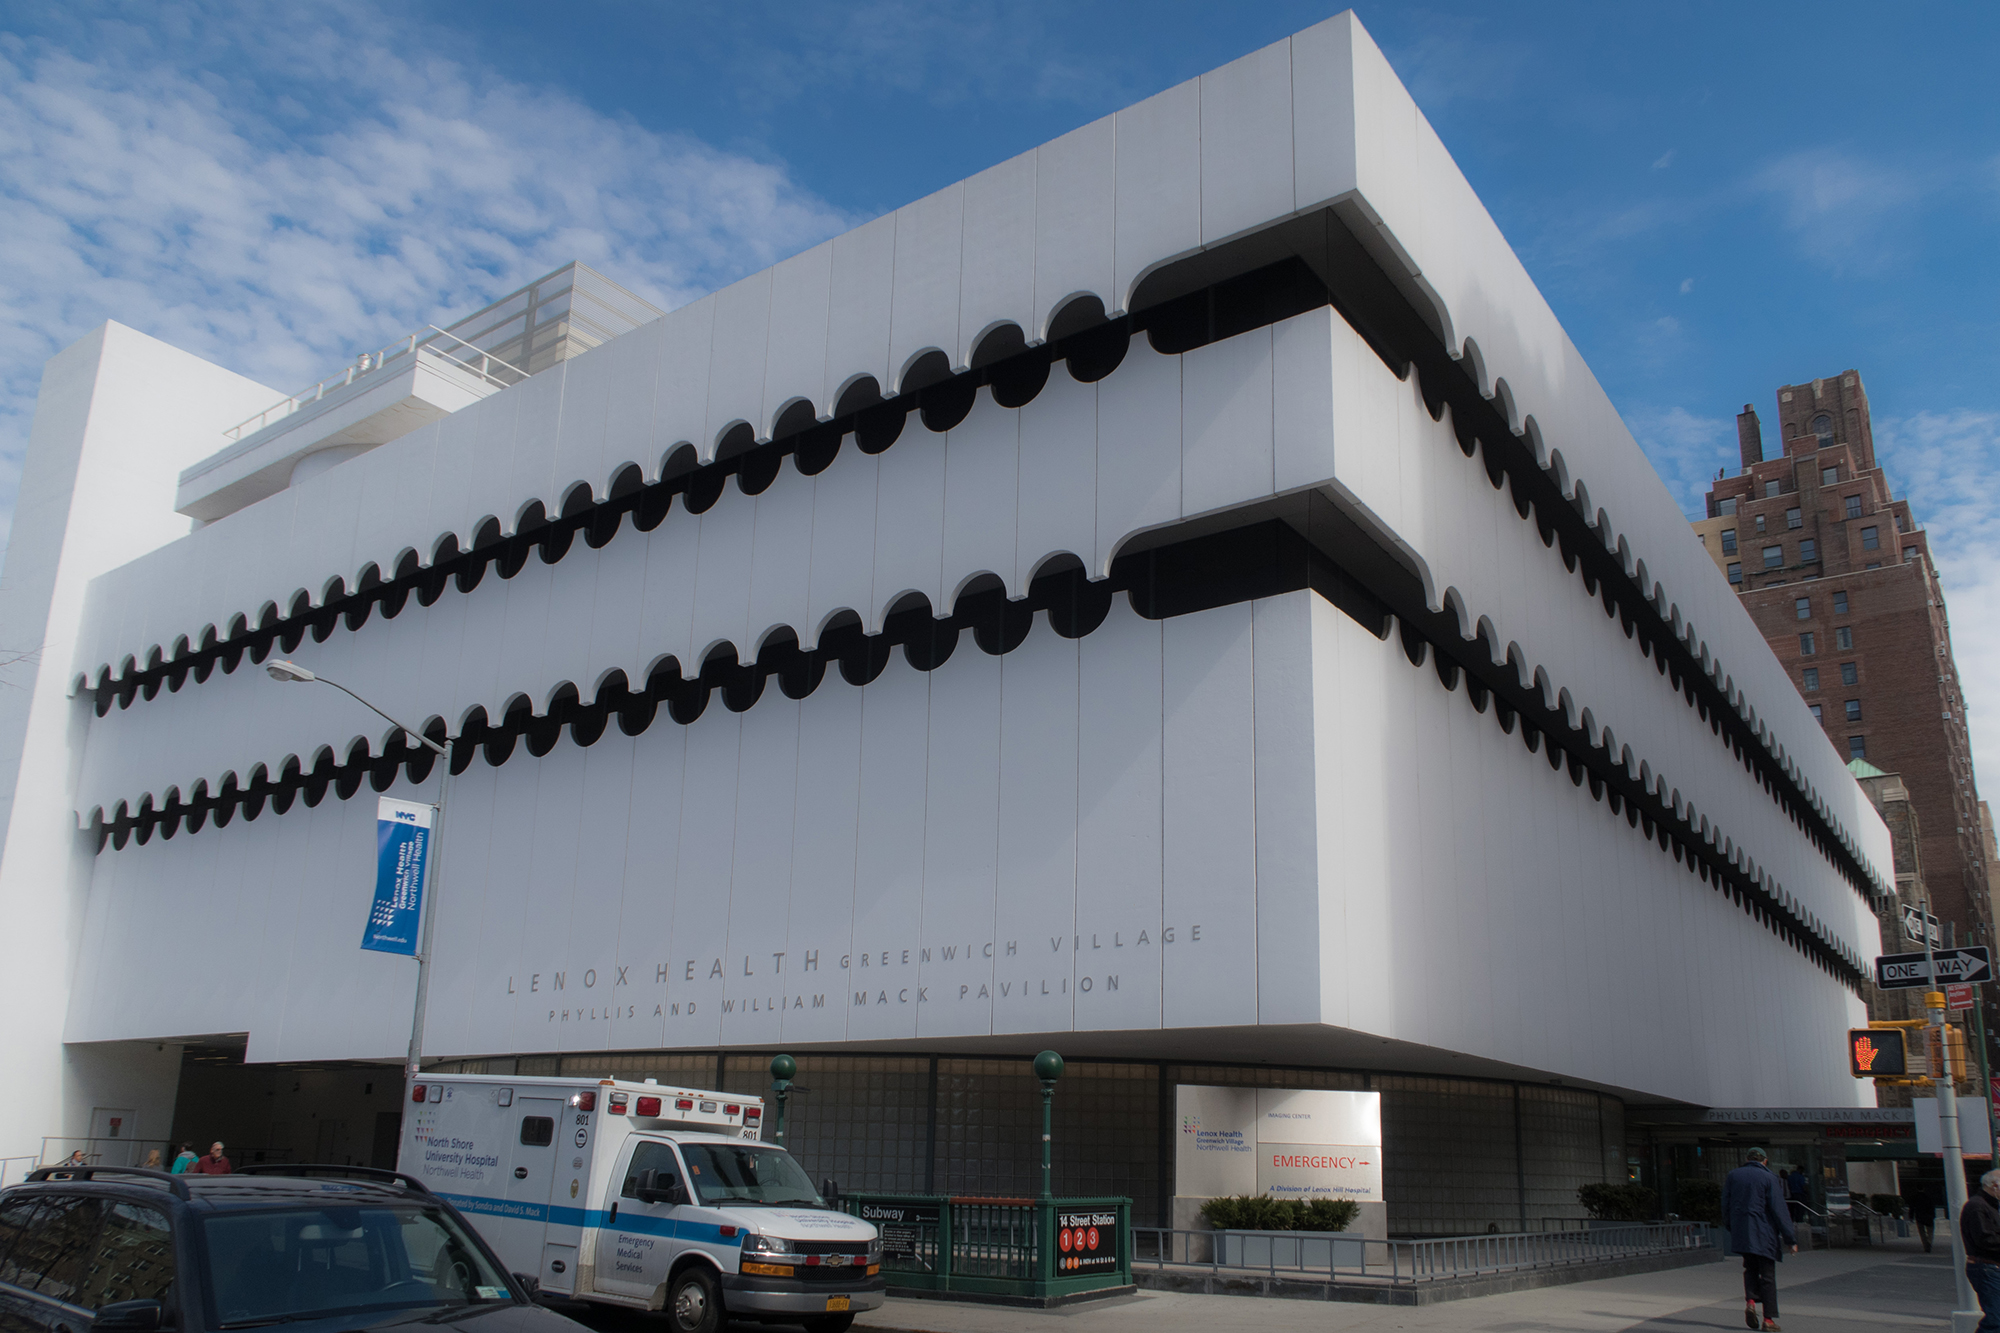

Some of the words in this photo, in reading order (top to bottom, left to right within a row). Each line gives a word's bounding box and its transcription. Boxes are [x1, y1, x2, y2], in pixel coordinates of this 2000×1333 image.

[396, 810, 416, 821] NYC
[396, 842, 406, 874] Health
[399, 869, 410, 909] Greenwich
[405, 842, 414, 868] Village
[408, 862, 420, 910] Northwell
[414, 832, 424, 862] Health
[391, 878, 402, 908] Lenox
[507, 965, 629, 994] LENOX
[656, 950, 819, 984] HEALTH
[840, 940, 1017, 968] GREENWICH
[1050, 925, 1201, 952] VILLAGE
[1886, 964, 1918, 978] ONE
[1937, 959, 1972, 974] WAY
[548, 1005, 635, 1022] PHYLLIS
[653, 1002, 696, 1018] AND
[722, 994, 826, 1013] WILLIAM
[854, 986, 928, 1006] MACK
[960, 975, 1119, 1000] PAVILION
[576, 1114, 589, 1126] 801
[1709, 1111, 1758, 1120] PHYLLIS
[1764, 1111, 1790, 1120] AND
[1797, 1111, 1854, 1120] WILLIAM
[1860, 1111, 1900, 1120] MACK
[742, 1130, 757, 1140] 801
[1826, 1127, 1910, 1138] EMERGENCY
[427, 1136, 449, 1148] North
[451, 1138, 474, 1150] Shore
[425, 1150, 463, 1165] University
[465, 1153, 498, 1168] Hospital
[1273, 1155, 1356, 1169] EMERGENCY
[423, 1164, 459, 1177] Northwell
[461, 1167, 484, 1180] Health
[468, 1200, 474, 1211] by
[493, 1204, 504, 1212] and
[504, 1204, 520, 1215] David
[526, 1207, 540, 1217] Mack
[863, 1205, 904, 1222] Subway
[1060, 1216, 1068, 1227] 14
[1070, 1215, 1090, 1227] Street
[1092, 1214, 1115, 1226] Station
[618, 1234, 655, 1249] Emergency
[617, 1249, 643, 1260] Medical
[616, 1262, 643, 1273] Services
